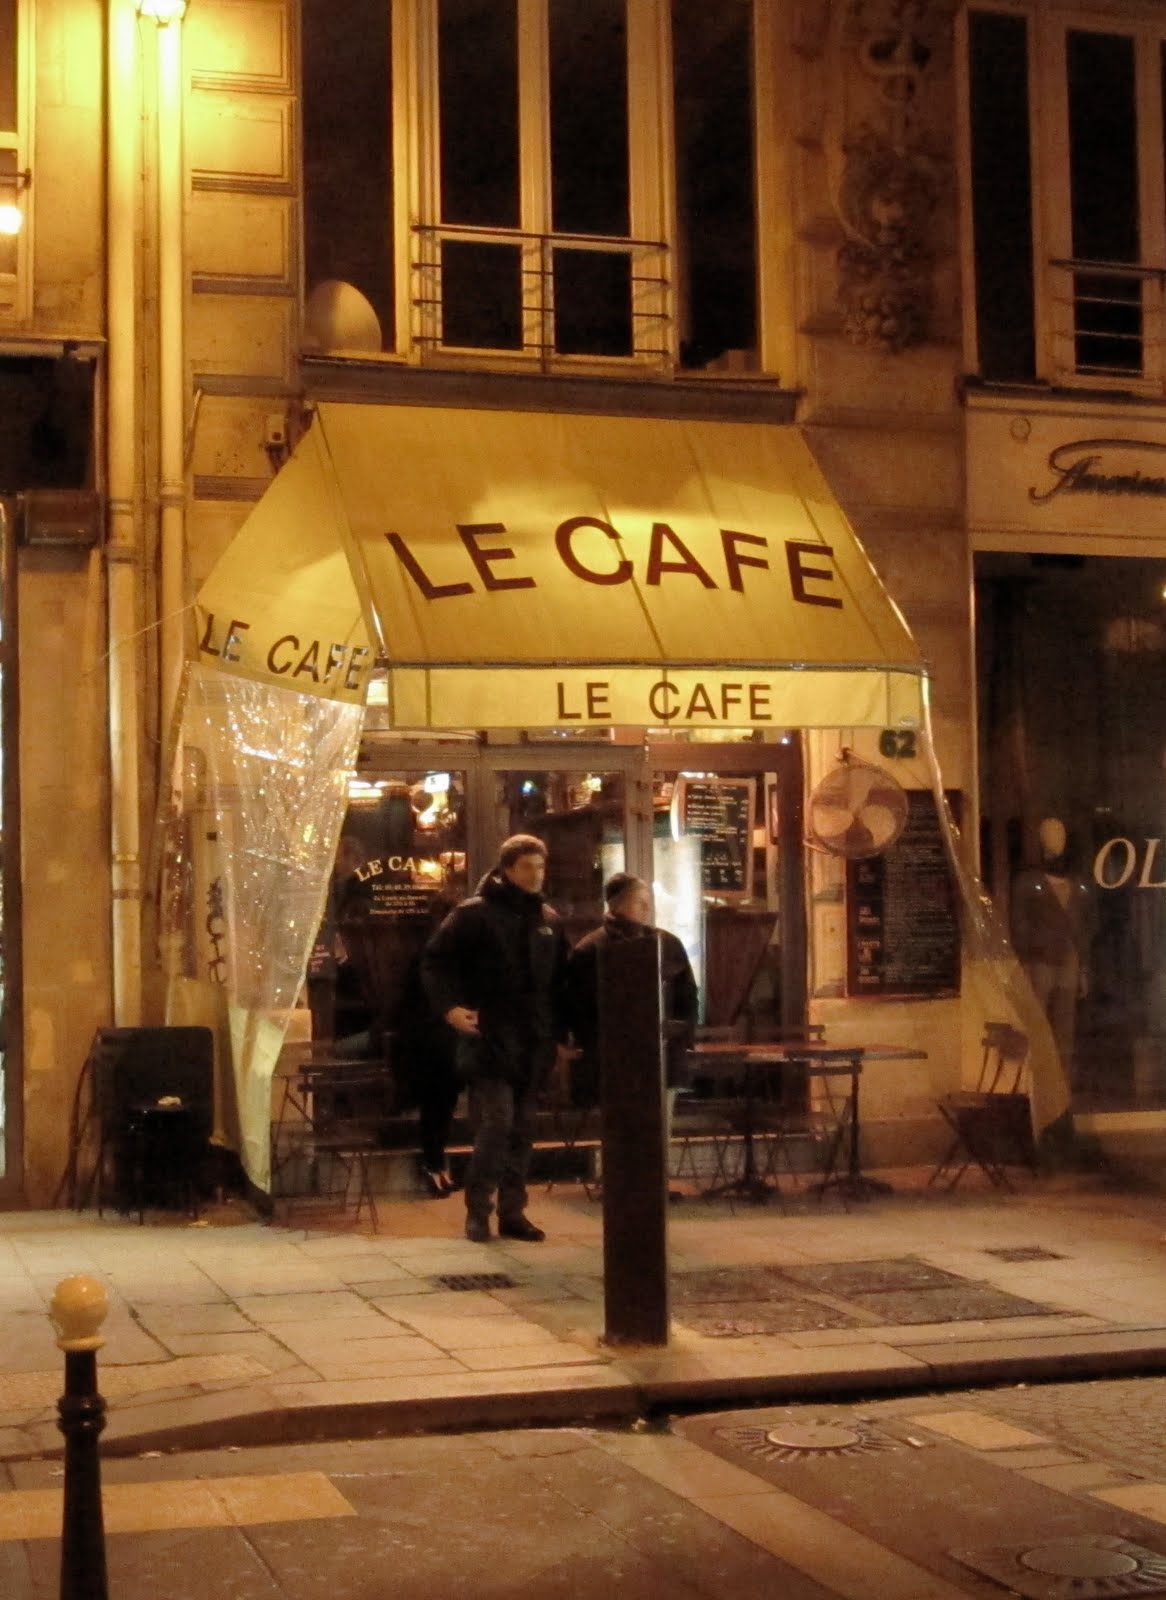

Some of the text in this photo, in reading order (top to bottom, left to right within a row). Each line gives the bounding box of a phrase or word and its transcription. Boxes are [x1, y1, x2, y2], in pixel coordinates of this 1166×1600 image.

[384, 516, 843, 609] LE CAFE
[200, 613, 369, 690] LE CAFE
[557, 681, 772, 720] LE CAFE
[880, 729, 917, 758] 62
[354, 856, 446, 882] LE CA
